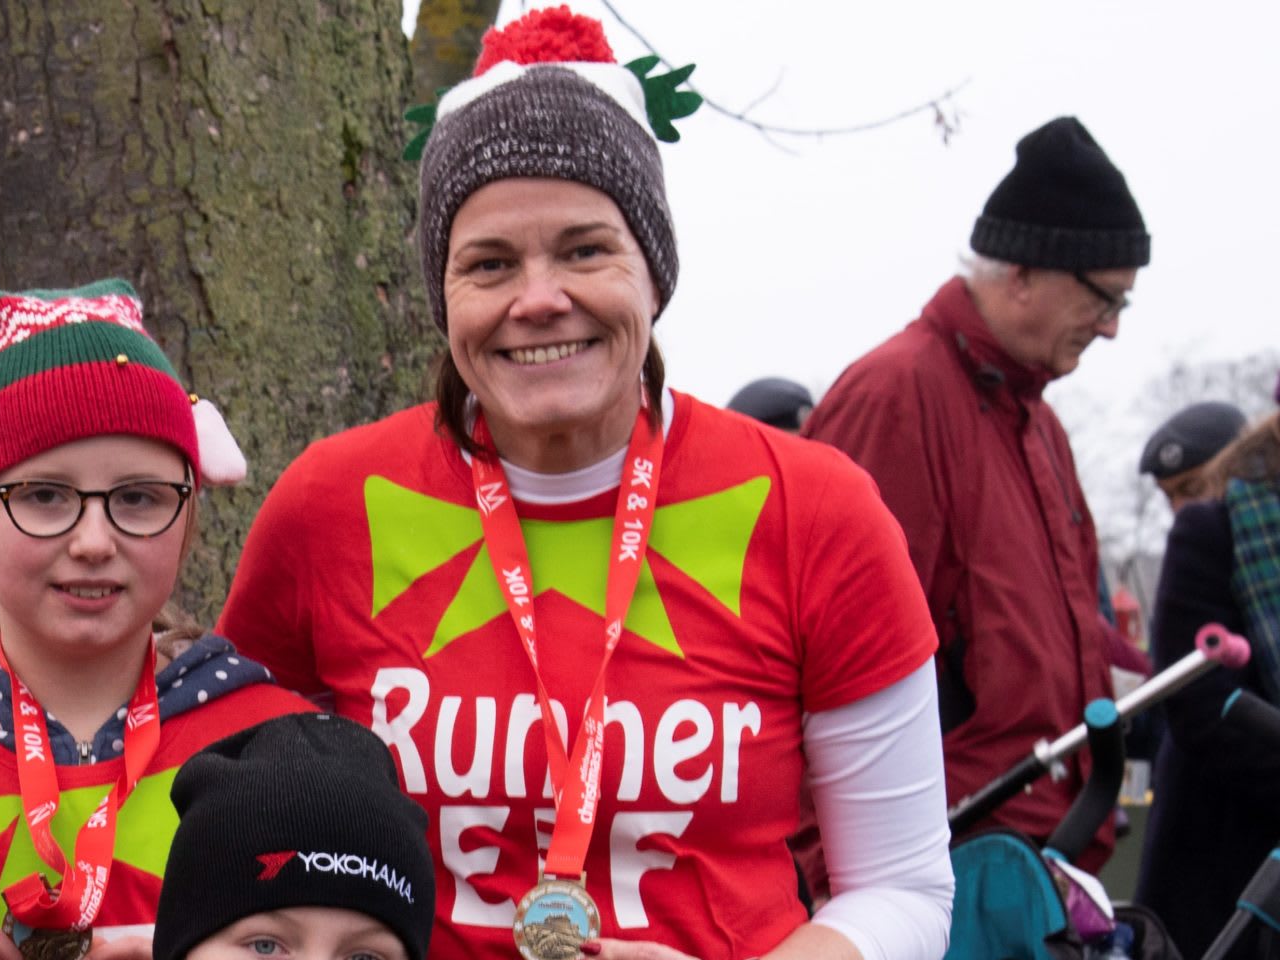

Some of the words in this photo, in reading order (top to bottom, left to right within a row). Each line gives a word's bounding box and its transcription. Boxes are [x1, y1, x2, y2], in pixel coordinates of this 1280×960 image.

[630, 457, 654, 489] 5K
[627, 494, 649, 511] &
[618, 519, 645, 562] 10K
[502, 566, 530, 607] 10K
[22, 722, 46, 762] 10K
[370, 667, 762, 804] Runner
[296, 851, 414, 904] YOKOHAMA
